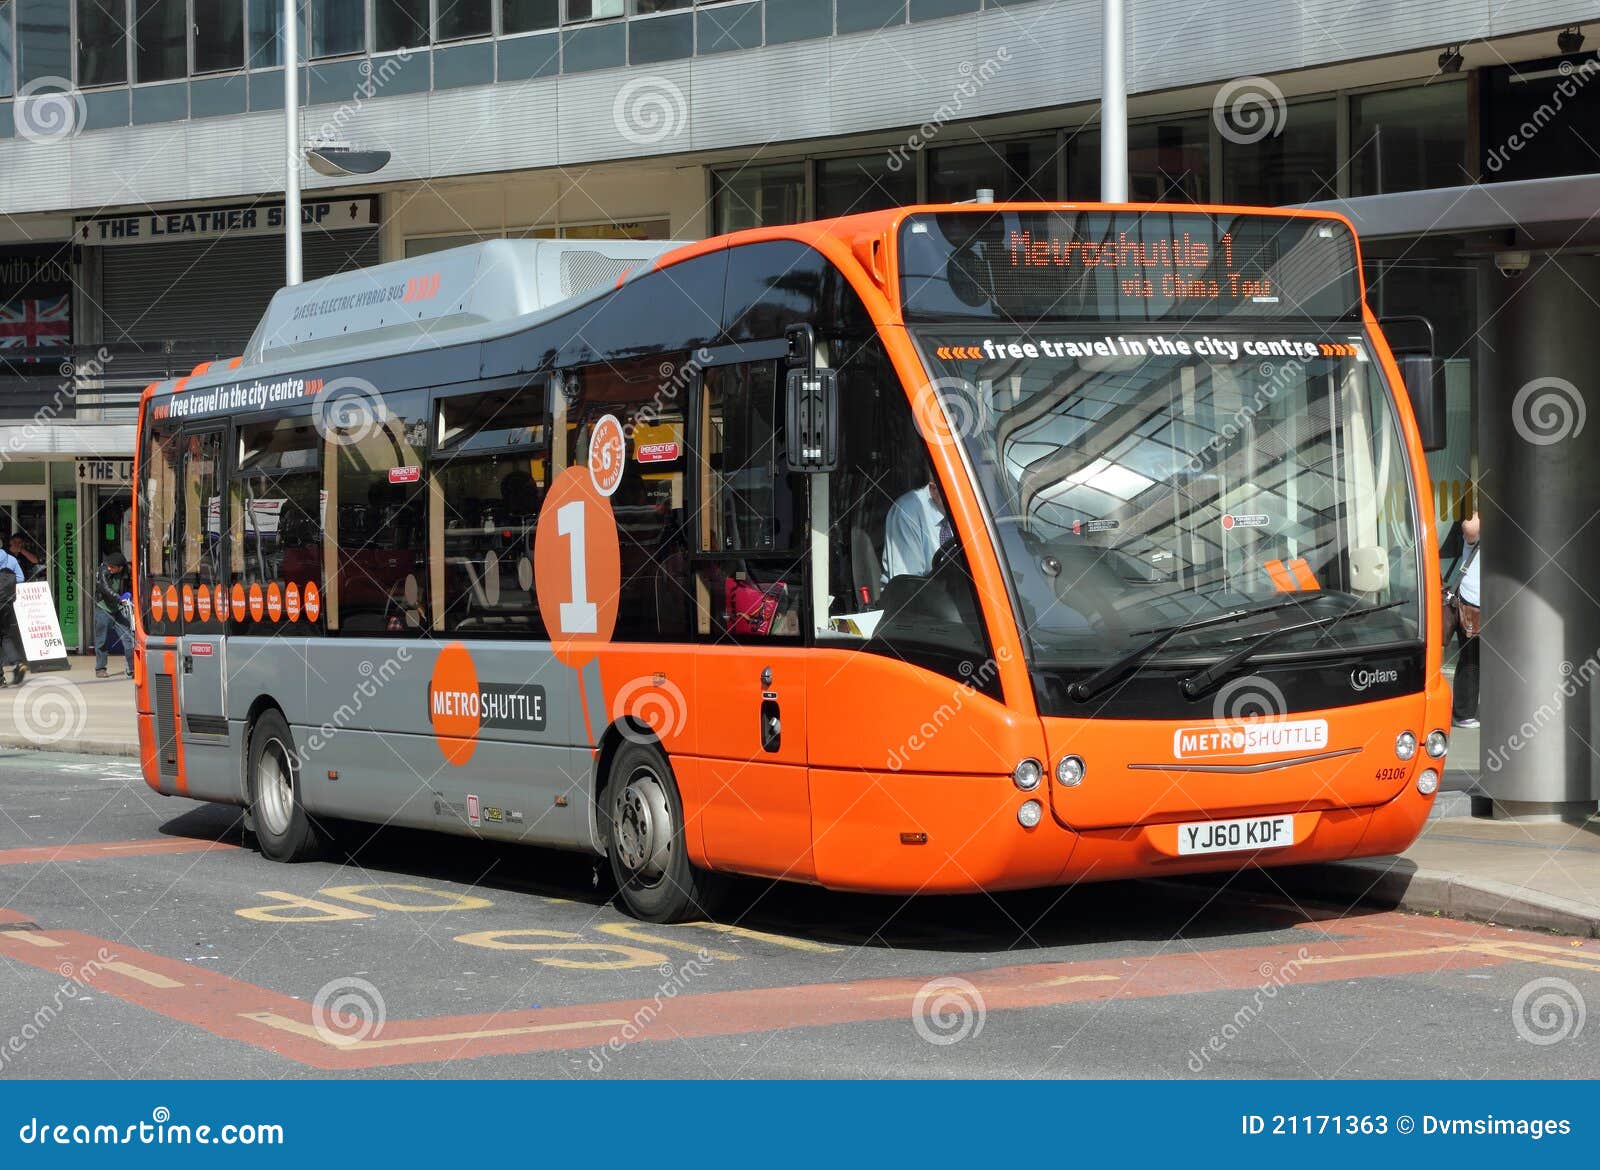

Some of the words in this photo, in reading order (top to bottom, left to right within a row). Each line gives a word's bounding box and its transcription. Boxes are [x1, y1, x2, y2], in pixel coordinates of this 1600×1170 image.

[98, 218, 139, 239] THE
[151, 210, 257, 235] LEATHER
[267, 204, 330, 227] SOP
[1011, 231, 1209, 267] Metroshuttle
[1221, 233, 1233, 267] 1
[34, 255, 72, 283] food
[356, 288, 386, 309] HYBRID
[387, 283, 406, 301] BUS
[1121, 274, 1153, 297] via
[1162, 273, 1219, 297] China
[983, 339, 1039, 360] free
[1040, 337, 1115, 359] travel
[1120, 336, 1147, 356] in
[1148, 336, 1192, 357] the
[1194, 336, 1239, 360] city
[1242, 339, 1320, 356] centre
[169, 394, 189, 418] free
[190, 387, 218, 414] travel
[219, 386, 229, 410] in
[230, 384, 247, 407] the
[248, 380, 268, 410] city
[269, 377, 304, 401] centre
[602, 442, 611, 470] 6
[88, 462, 114, 480] THE
[65, 522, 75, 602] co-operative
[557, 501, 598, 634] 1
[65, 606, 74, 625] The
[44, 639, 62, 648] OPEN
[1358, 668, 1398, 687] Optare
[1375, 767, 1405, 781] 49106
[1188, 823, 1240, 849] YJ60
[1247, 819, 1285, 844] KDF
